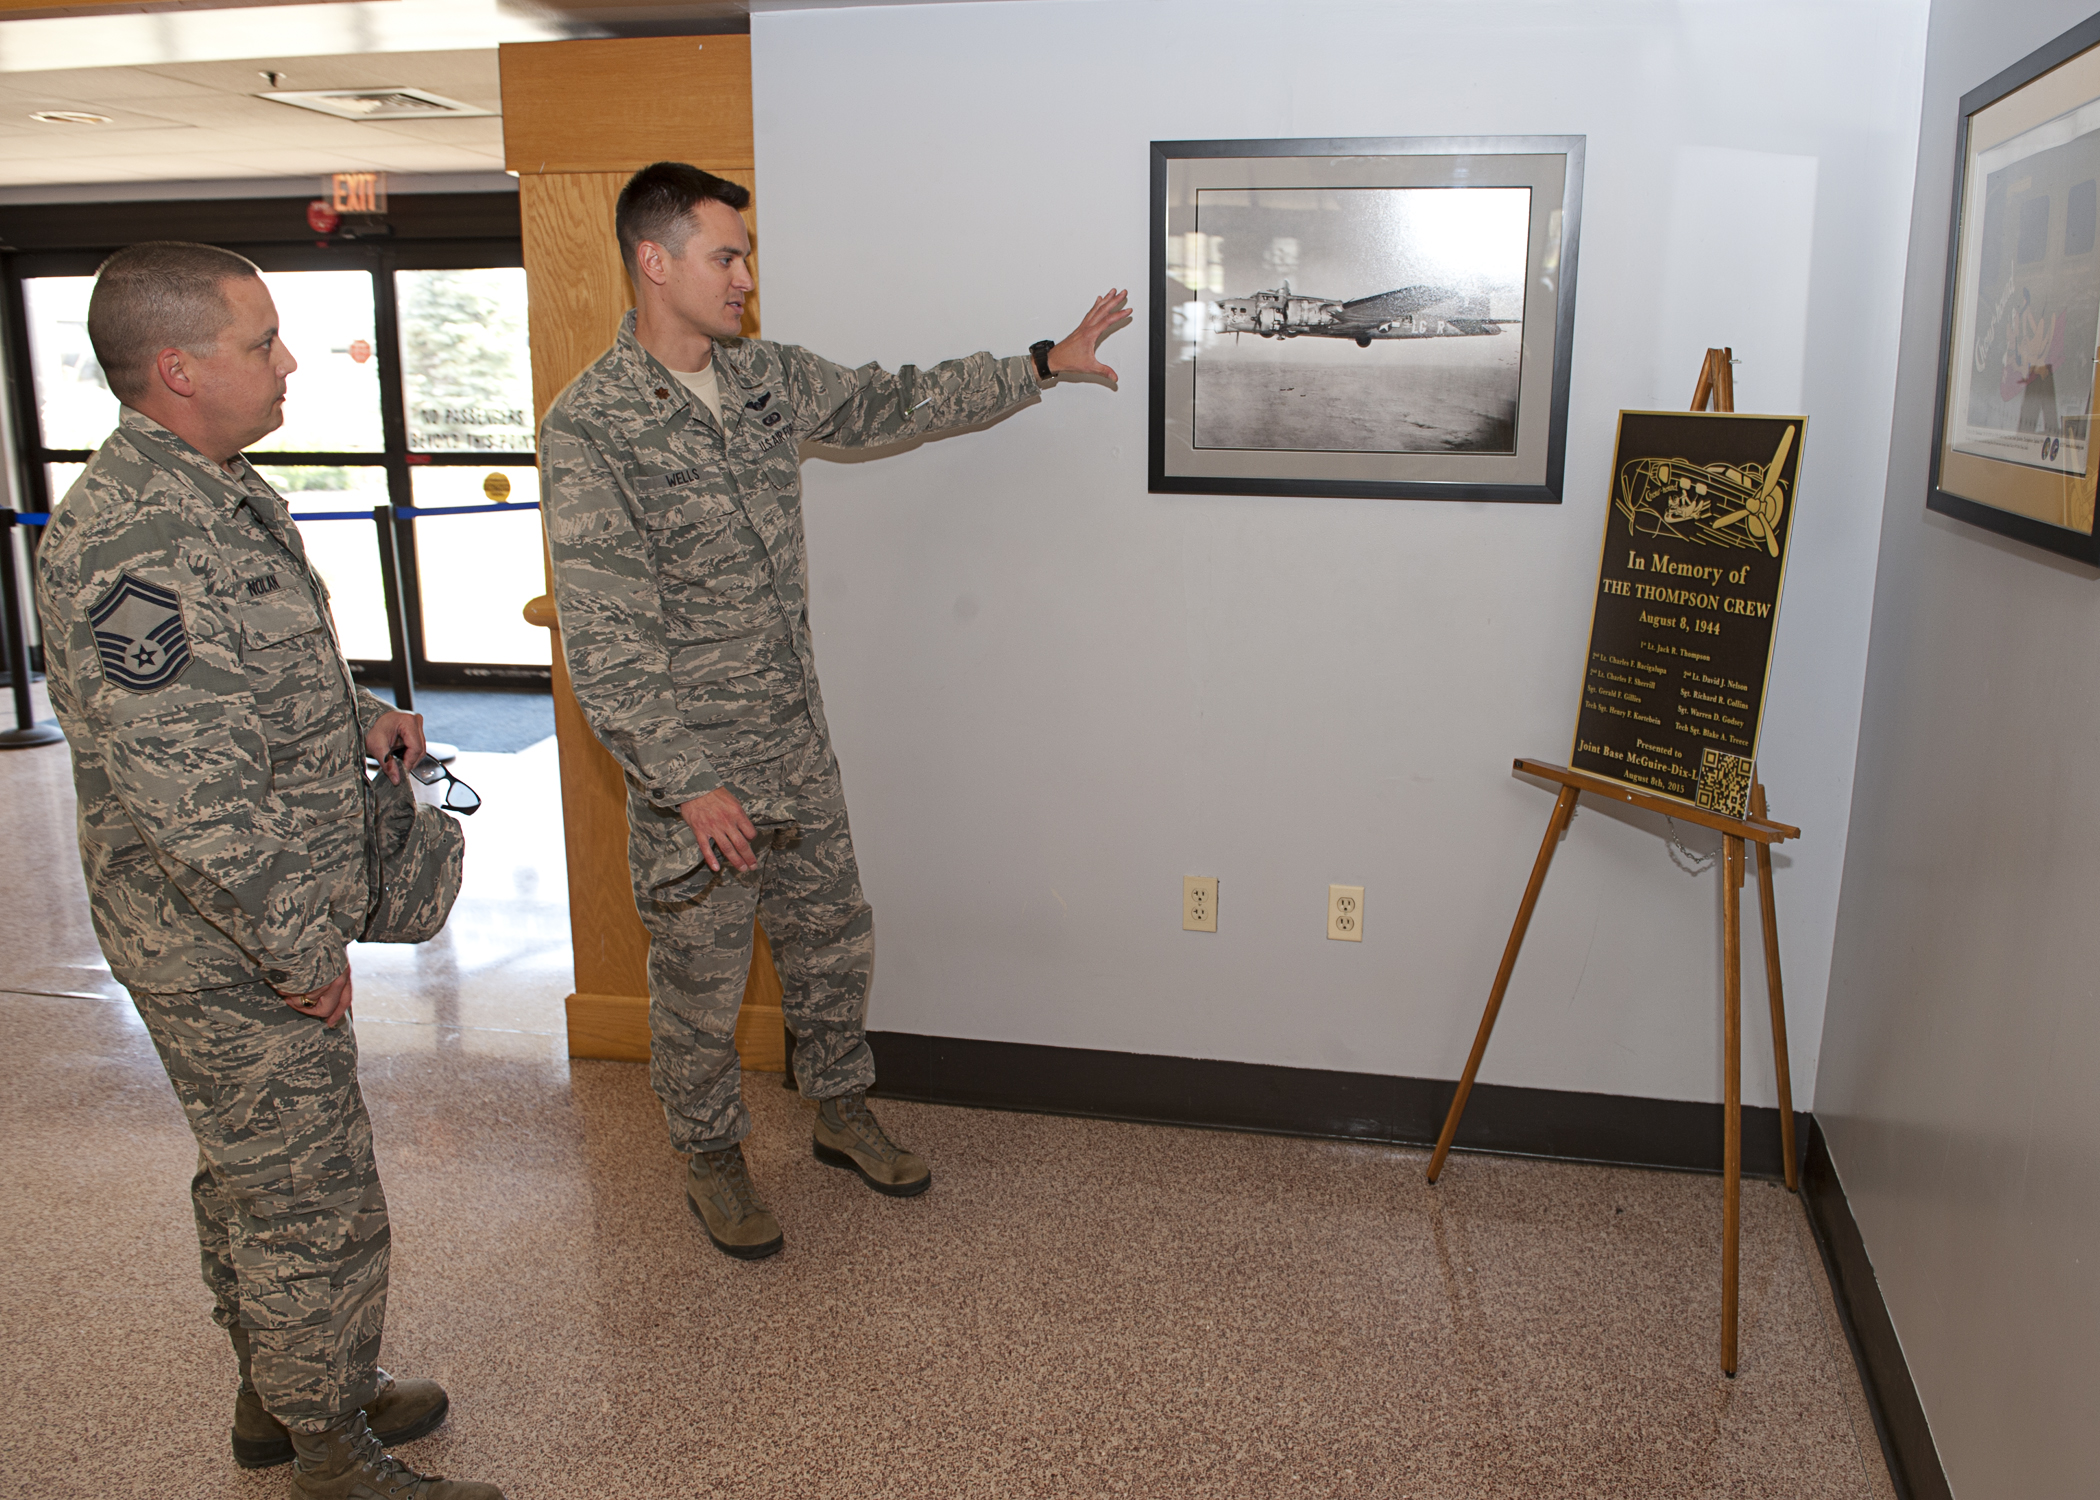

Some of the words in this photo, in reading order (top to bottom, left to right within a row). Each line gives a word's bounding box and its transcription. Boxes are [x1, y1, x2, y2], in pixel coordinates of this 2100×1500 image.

[332, 173, 377, 212] EXIT
[421, 409, 439, 425] NO
[665, 468, 700, 488] WELLS
[1627, 550, 1645, 570] In
[1651, 554, 1723, 586] Memory
[1729, 566, 1750, 584] of
[247, 574, 281, 597] NOLAN
[1603, 579, 1631, 596] THE
[1635, 583, 1720, 610] THOMPSON
[1724, 598, 1771, 618] CREW
[1639, 610, 1676, 628] August
[1680, 617, 1690, 632] 8,
[1695, 620, 1720, 635] 1944
[1609, 656, 1629, 666] Charles
[1647, 643, 1655, 651] Lt.
[1656, 644, 1670, 653] Jack
[1671, 647, 1678, 655] R.
[1680, 649, 1710, 661] Thompson
[1607, 673, 1626, 683] Charles
[1692, 673, 1700, 681] Lt.
[1702, 675, 1720, 685] David
[1720, 679, 1725, 688] J.
[1727, 680, 1747, 691] Nelson
[1588, 685, 1597, 694] Sgt.
[1599, 687, 1616, 697] Gerald
[1680, 688, 1691, 698] Sgt.
[1693, 691, 1717, 703] Richard
[1718, 696, 1725, 704] R.
[1727, 699, 1748, 710] Collins
[1585, 700, 1596, 709] Tech
[1598, 704, 1607, 713] Sgt.
[1609, 706, 1626, 718] Henry
[1678, 705, 1688, 715] Sgt.
[1691, 708, 1712, 720] Warren
[1714, 713, 1720, 721] D.
[1722, 715, 1744, 728] Godsey
[1676, 722, 1688, 732] Tech
[1690, 726, 1701, 736] Sgt.
[1703, 728, 1719, 739] Blake
[1730, 735, 1749, 746] Treece
[1578, 740, 1600, 754] Joint
[1603, 746, 1624, 760] Base
[1636, 739, 1673, 756] Presented
[1674, 750, 1682, 758] to
[1624, 770, 1648, 783] August
[1650, 778, 1665, 790] 8th,
[1668, 781, 1685, 793] 2015
